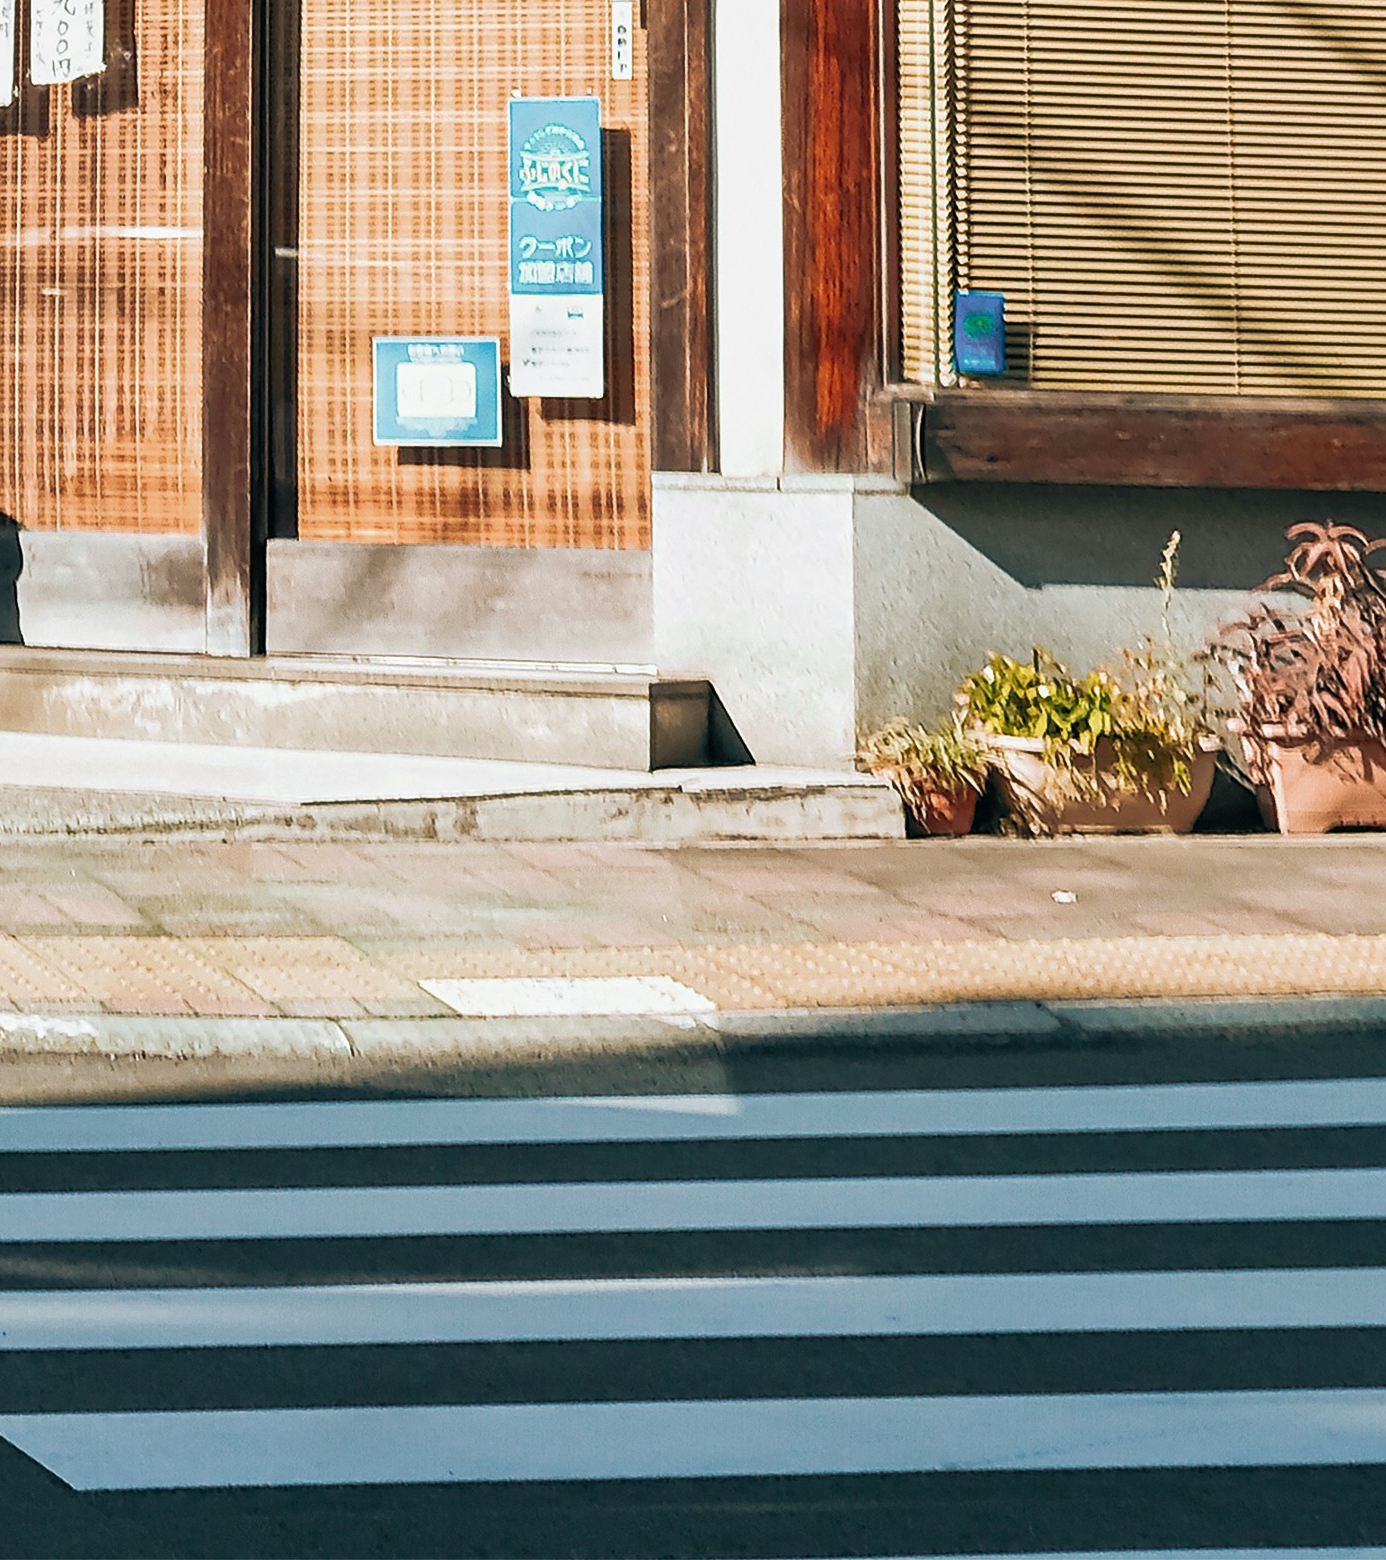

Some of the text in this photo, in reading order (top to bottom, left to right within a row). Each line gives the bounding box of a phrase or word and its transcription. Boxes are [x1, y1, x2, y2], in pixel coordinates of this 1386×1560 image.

[518, 158, 590, 188] ふじのくに
[518, 234, 593, 259] クーポン
